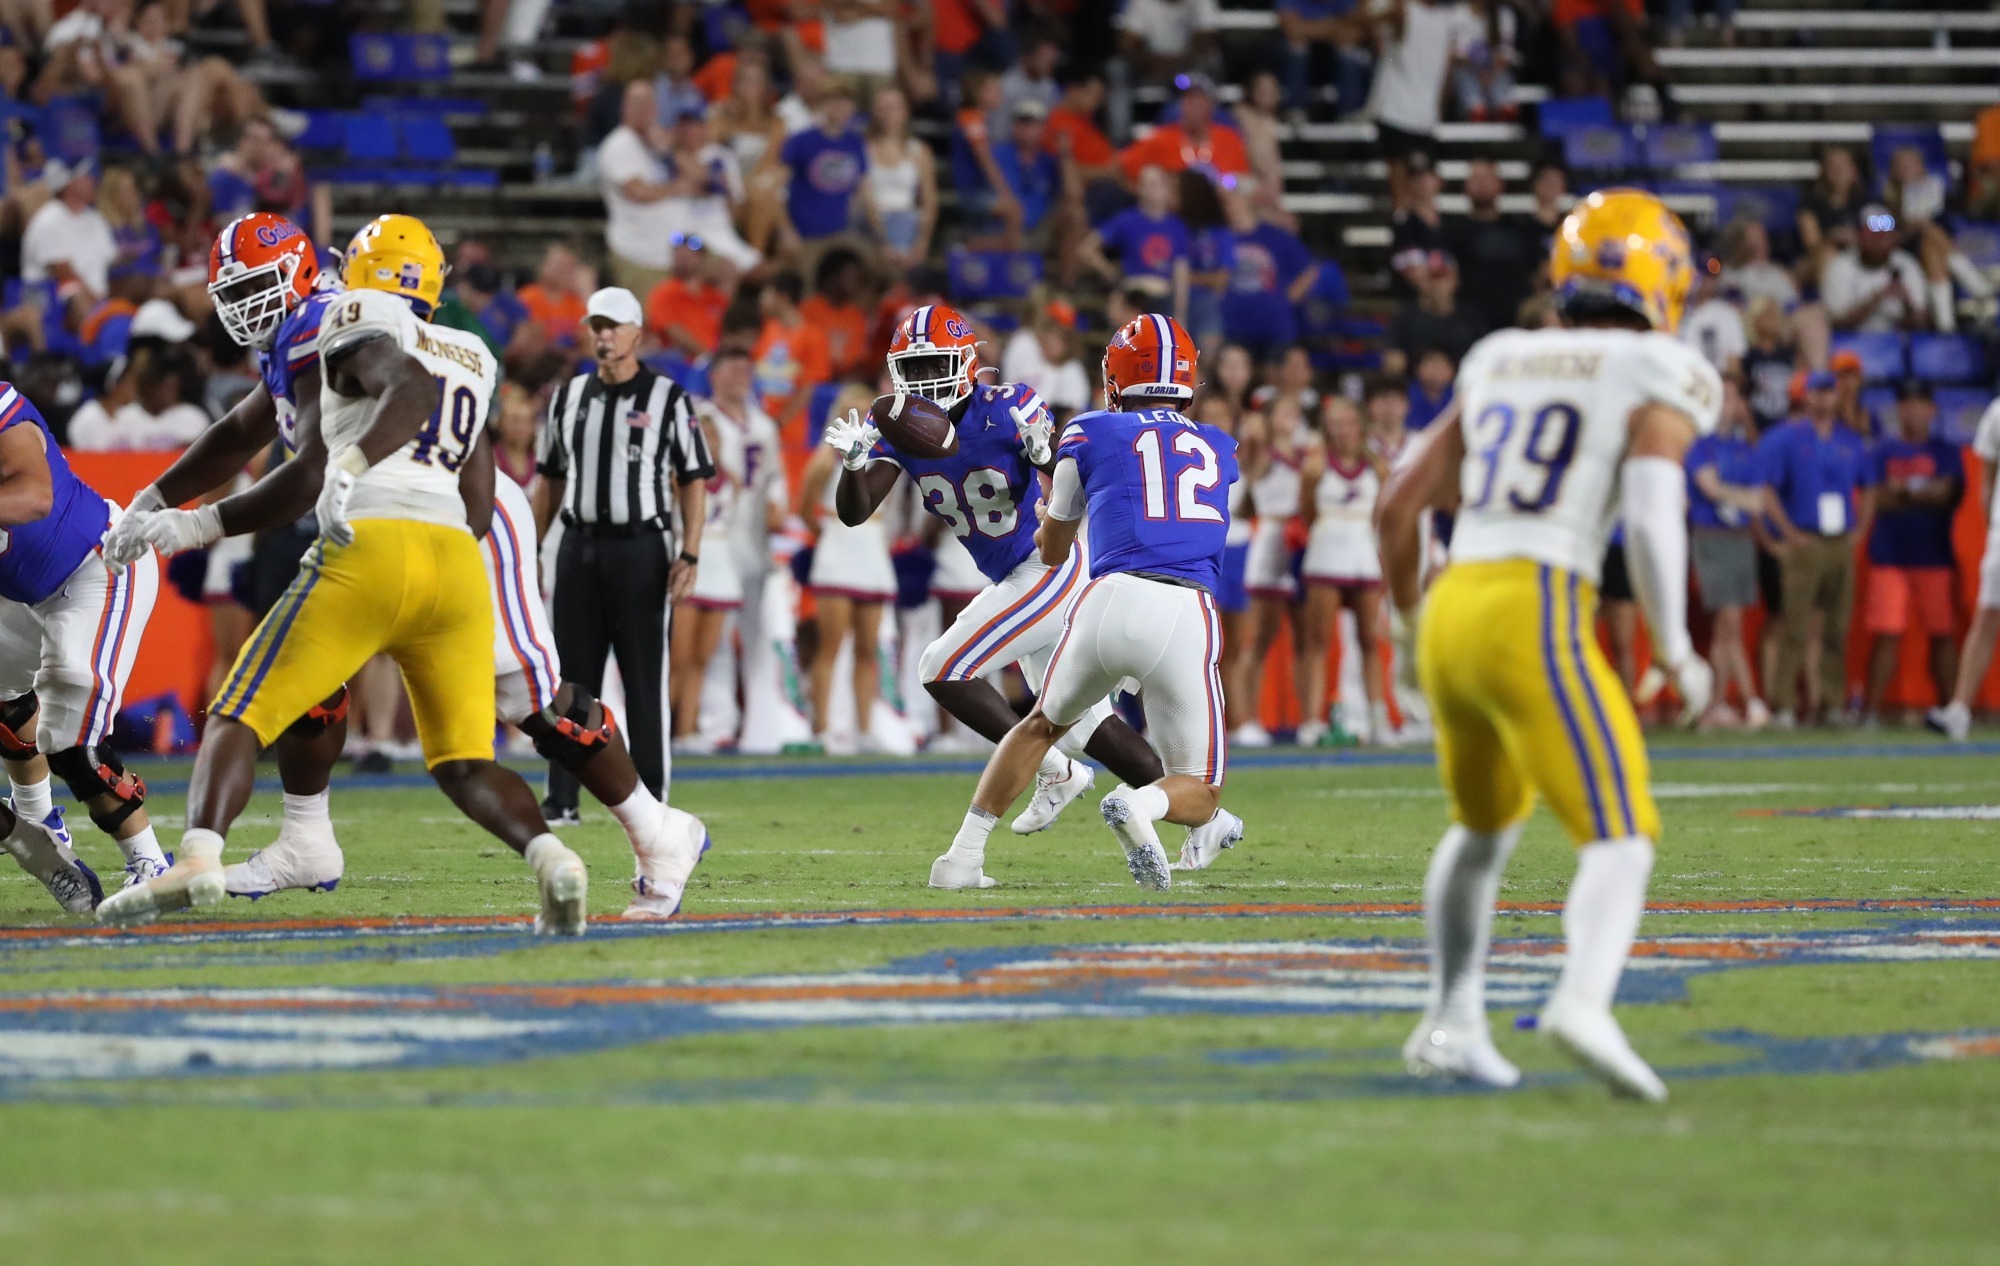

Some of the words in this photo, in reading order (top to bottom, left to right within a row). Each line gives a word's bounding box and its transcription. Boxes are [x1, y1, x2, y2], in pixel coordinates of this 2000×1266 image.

[1145, 386, 1179, 395] FLORIDA
[1132, 428, 1226, 525] 12
[1471, 402, 1582, 515] 39
[919, 466, 1020, 540] 38
